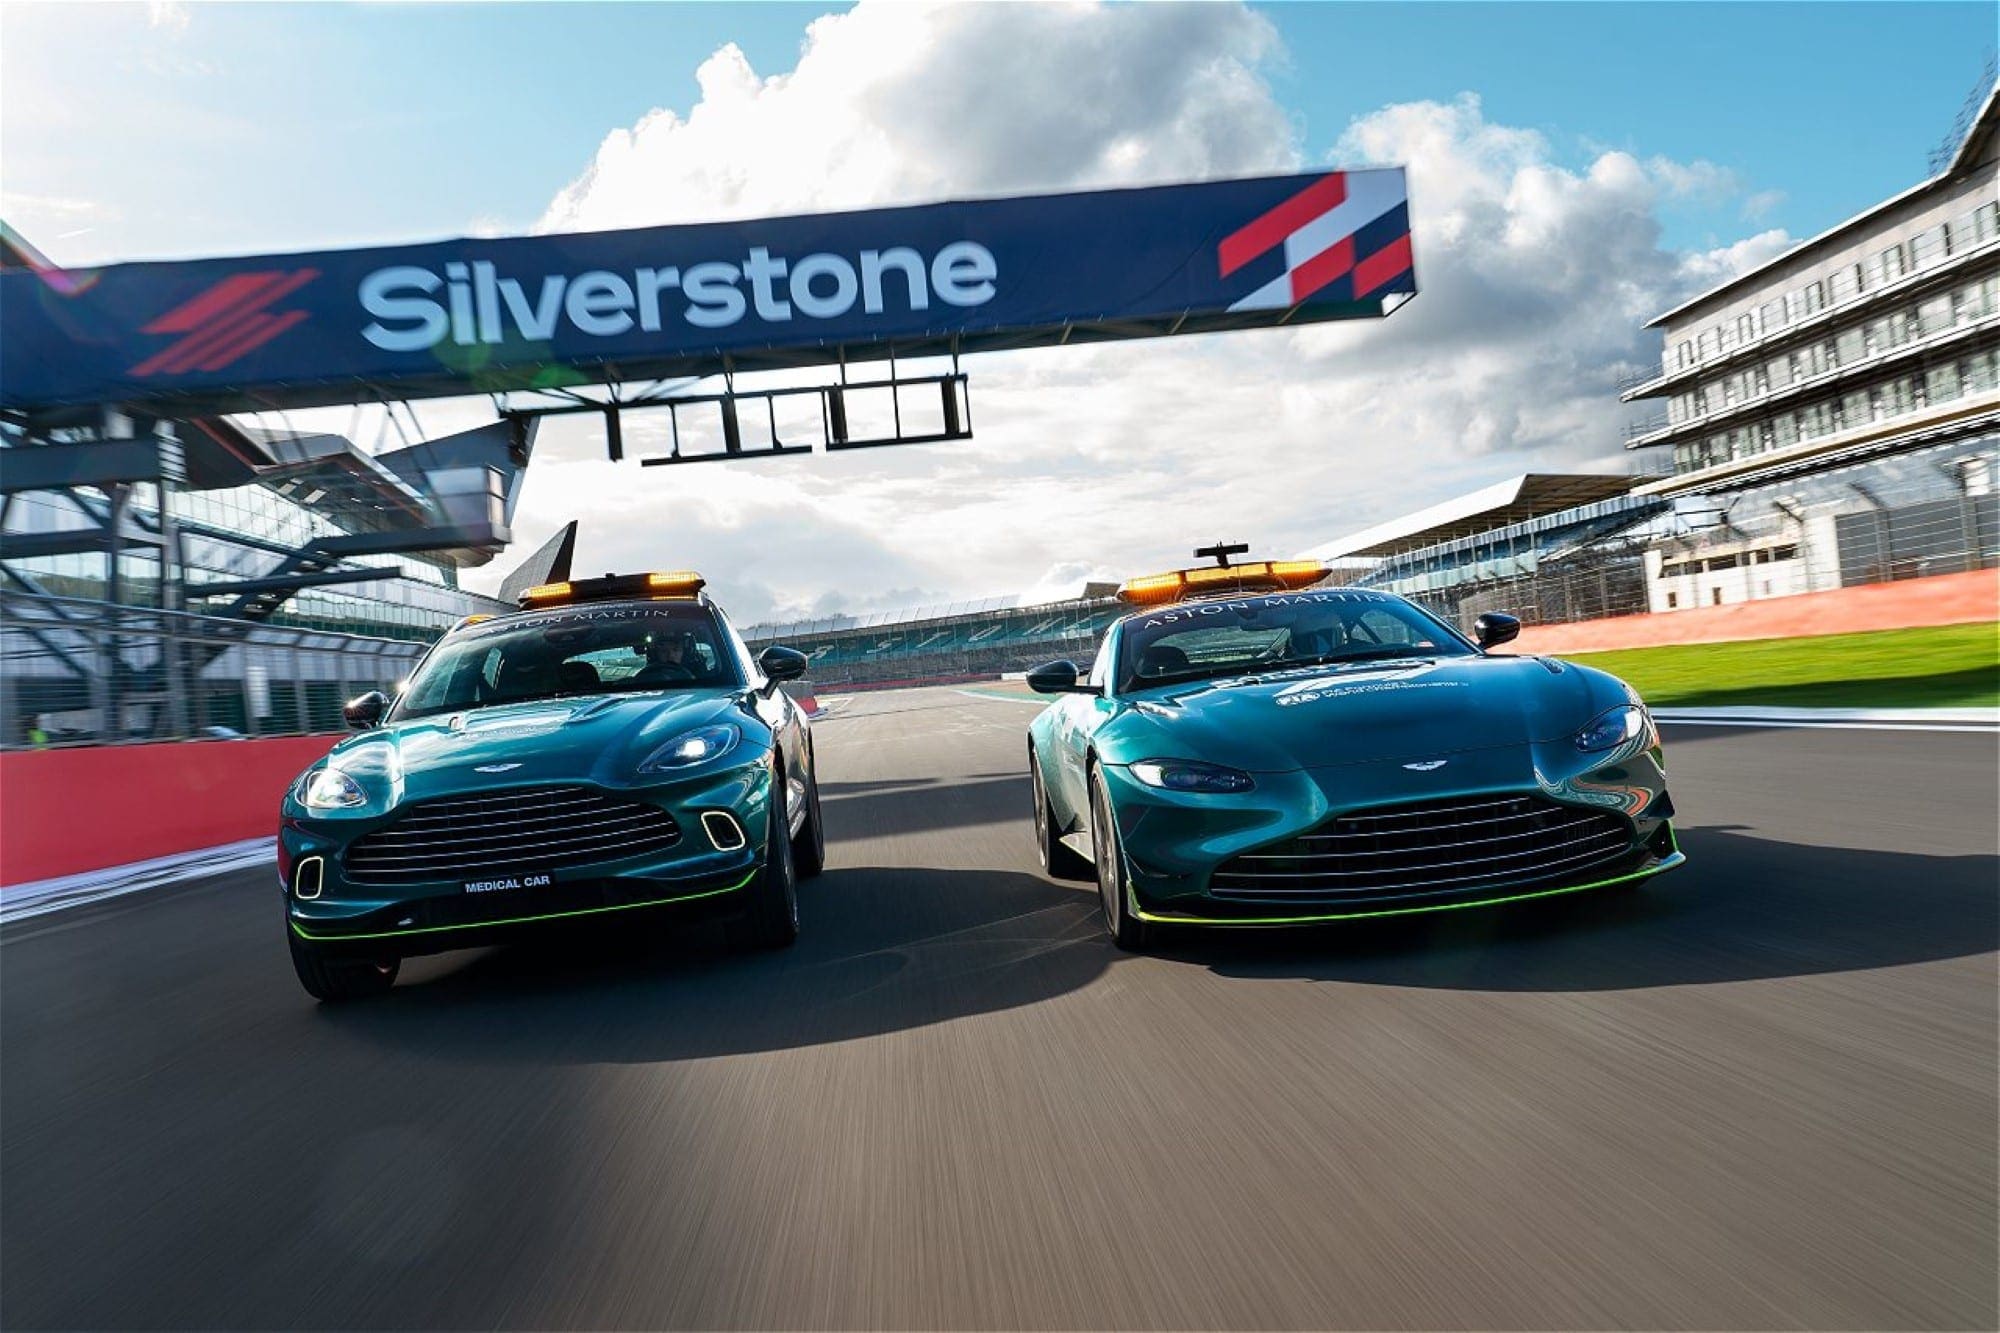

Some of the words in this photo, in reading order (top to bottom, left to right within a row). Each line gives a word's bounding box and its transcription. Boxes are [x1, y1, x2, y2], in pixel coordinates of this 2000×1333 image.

[358, 240, 998, 351] Silverstone
[574, 610, 669, 620] MARTIN
[1144, 602, 1249, 630] ASTON
[1264, 594, 1386, 607] MARTIN
[465, 879, 521, 893] MEDICAL
[524, 875, 551, 887] CAR
